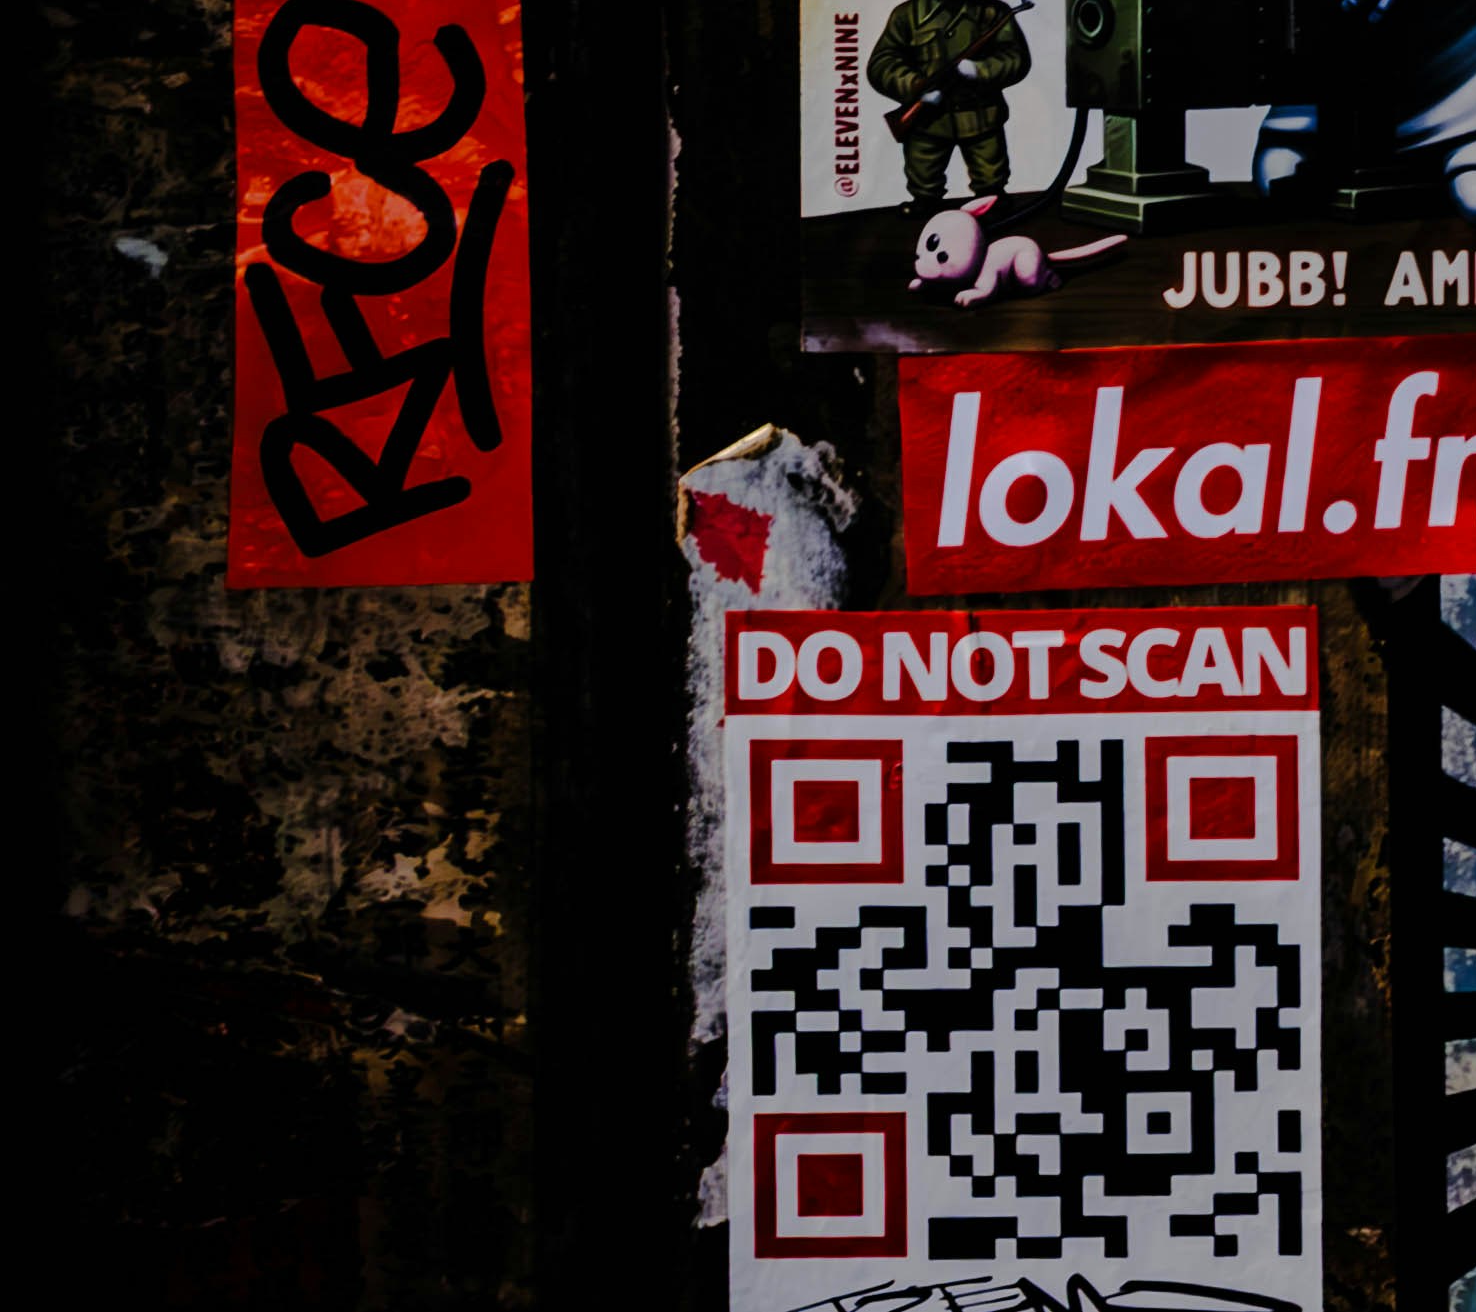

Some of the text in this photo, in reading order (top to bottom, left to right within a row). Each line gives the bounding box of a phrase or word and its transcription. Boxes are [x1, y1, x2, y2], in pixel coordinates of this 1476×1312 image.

[1162, 249, 1349, 311] JUBB!
[736, 625, 1308, 703] DO NOT SCAN
